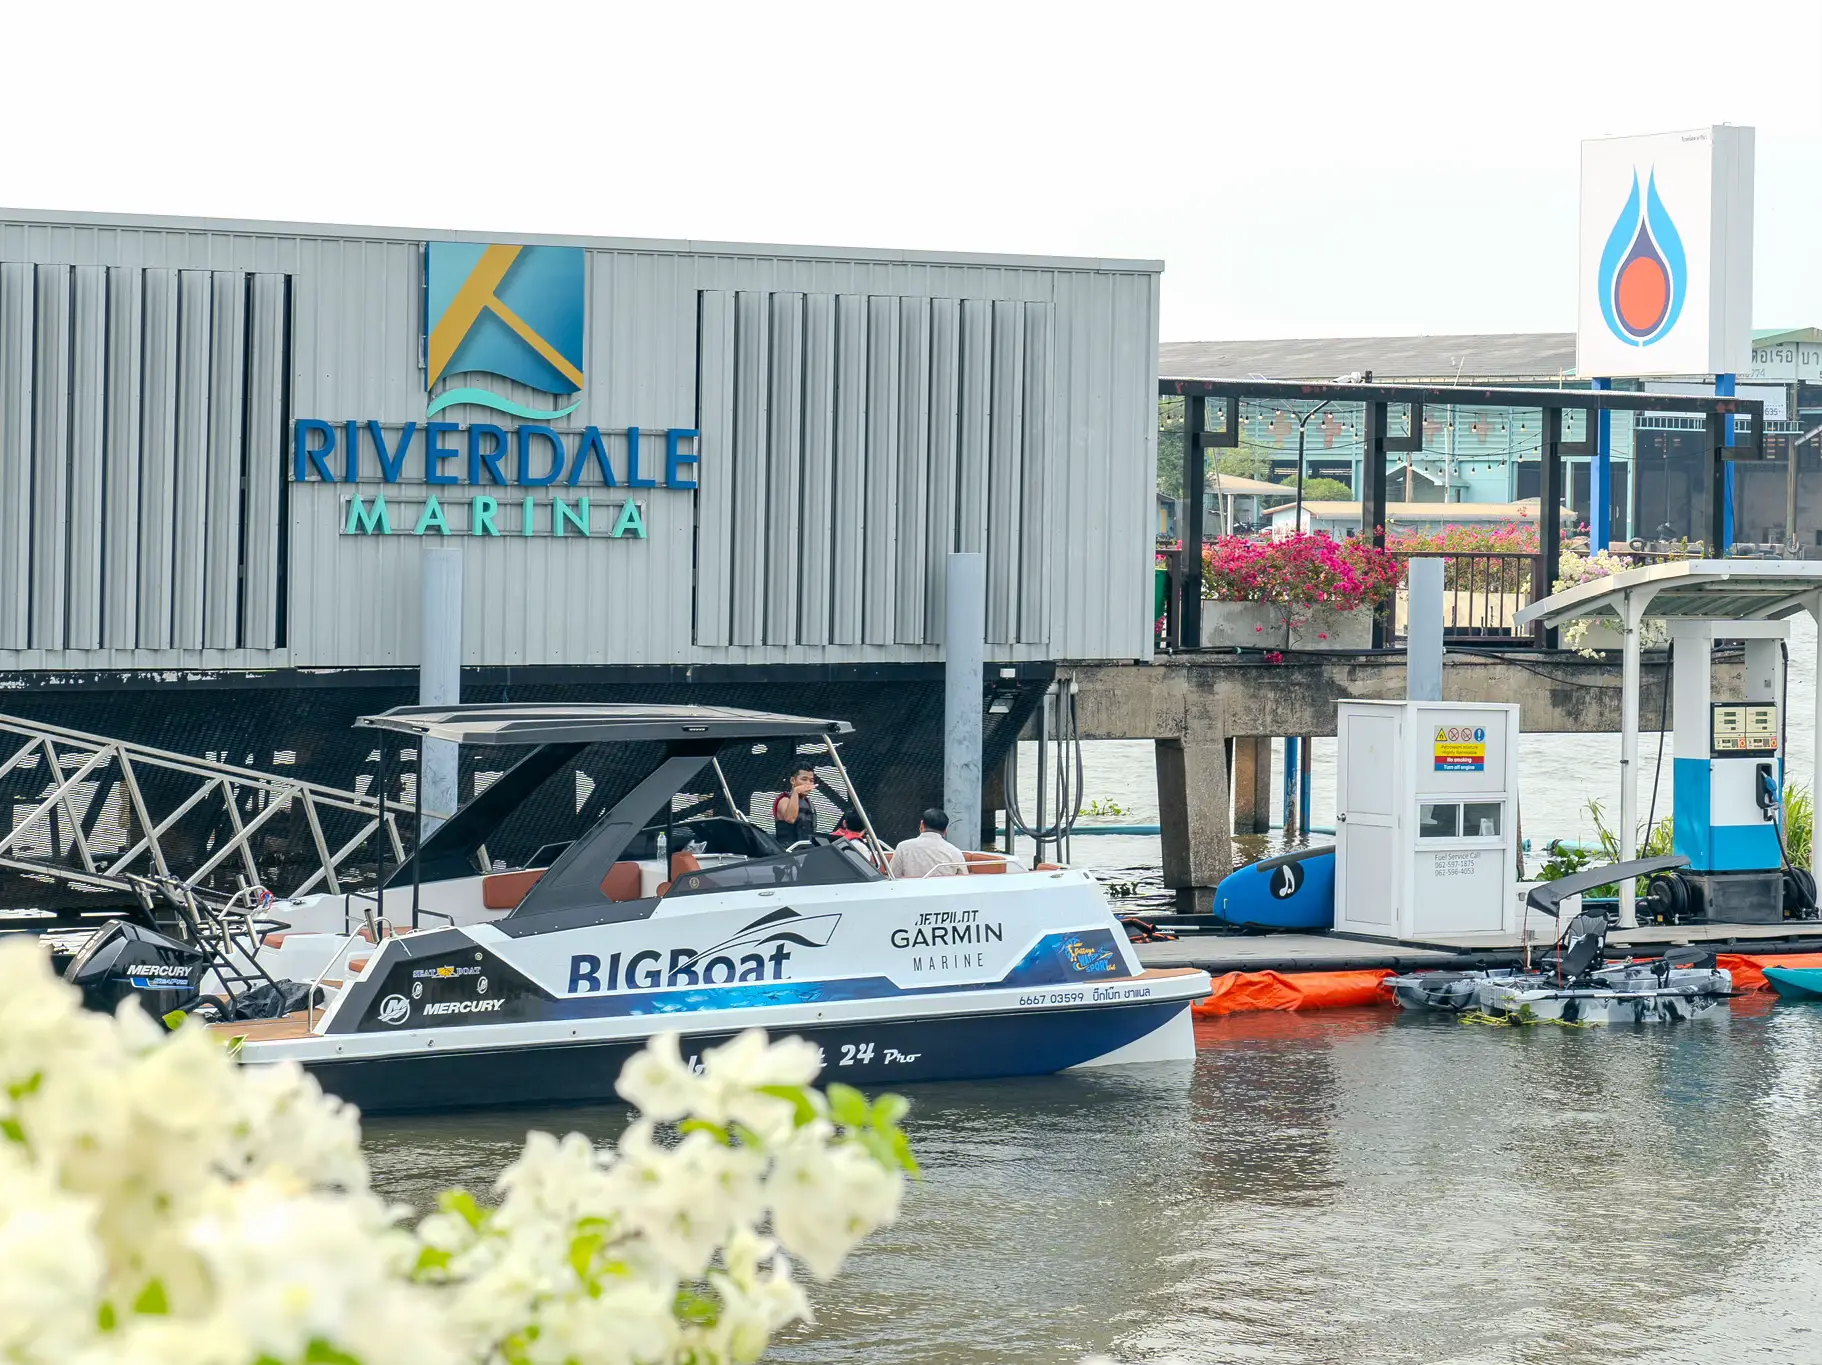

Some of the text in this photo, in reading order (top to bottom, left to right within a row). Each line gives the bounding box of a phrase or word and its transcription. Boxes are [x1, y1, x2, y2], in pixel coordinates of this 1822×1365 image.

[293, 419, 700, 489] RIVERDALE
[344, 493, 648, 539] MARINA
[1434, 851, 1481, 861] Fuel Service Call
[914, 909, 979, 926] JETPILOT
[890, 922, 1003, 949] GARMIN
[913, 952, 984, 971] MARINE
[126, 964, 193, 977] MERCURY
[412, 966, 482, 978] SEAT BOAT
[423, 999, 506, 1016] MERCURY
[1019, 994, 1046, 1006] 6667
[1049, 992, 1085, 1004] 03599
[839, 1043, 875, 1066] 24
[883, 1048, 922, 1065] Pro
